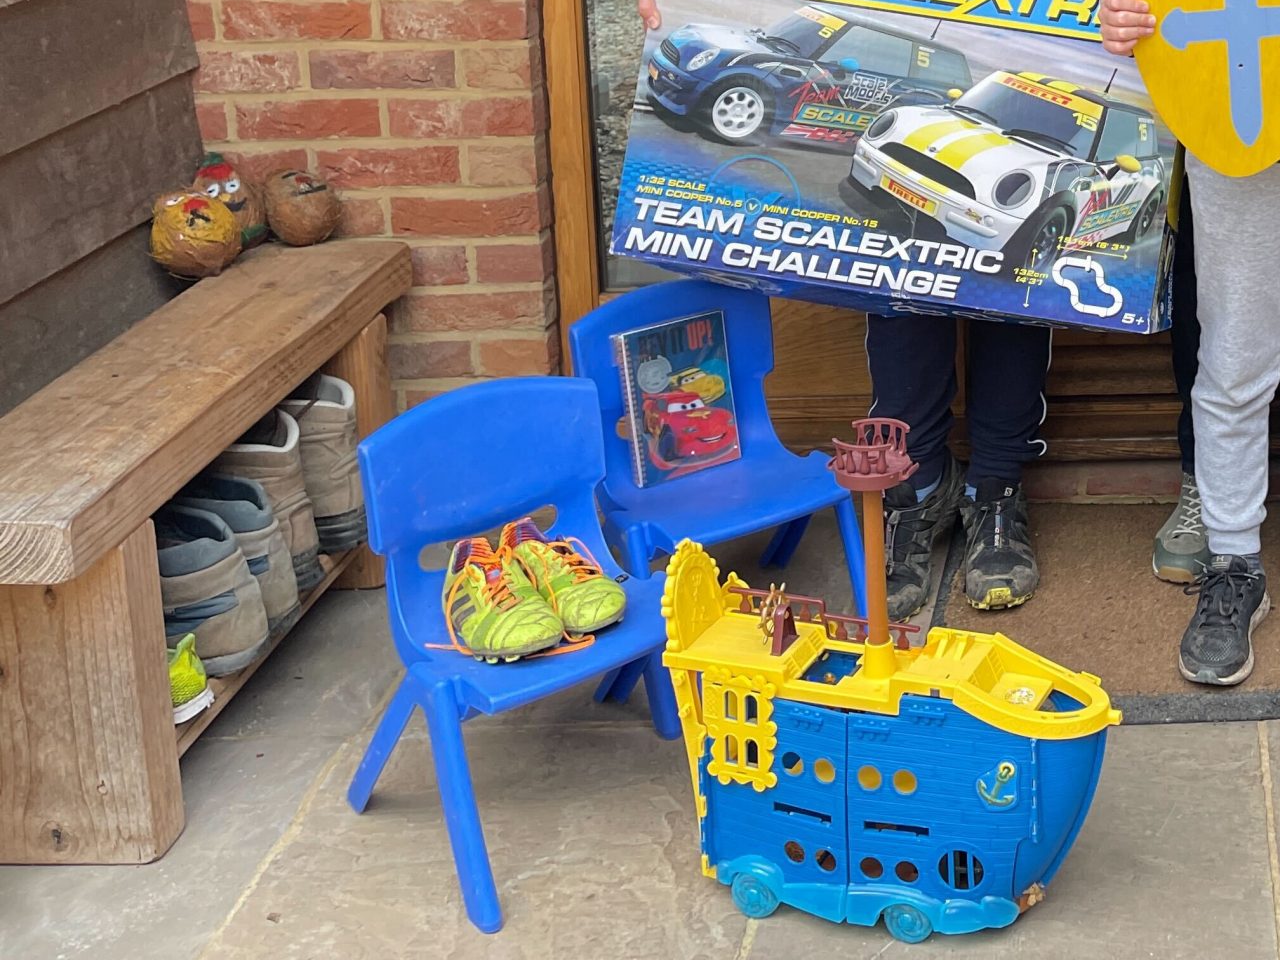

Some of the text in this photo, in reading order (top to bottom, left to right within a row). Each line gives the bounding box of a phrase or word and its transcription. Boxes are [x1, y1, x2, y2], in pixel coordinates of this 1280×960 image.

[818, 26, 835, 38] 5
[916, 50, 930, 68] 5
[853, 73, 887, 90] Scale
[1002, 76, 1073, 106] PIRELLI
[802, 106, 874, 129] SCALE
[1072, 111, 1101, 132] 15
[639, 175, 707, 192] 1:32 SCALE
[888, 179, 928, 209] PIRELLI
[636, 185, 663, 196] MINI
[665, 189, 713, 203] COOPER
[716, 196, 743, 208] No.5
[762, 204, 788, 215] MINI
[791, 208, 840, 222] COOPER
[843, 216, 879, 228] No.15
[634, 197, 1005, 274] TEAM SCALEXTRIC
[624, 227, 961, 299] MINI CHALLENGE
[1013, 267, 1049, 279] 132cm
[1121, 312, 1145, 326] 5+
[687, 319, 713, 351] UP!
